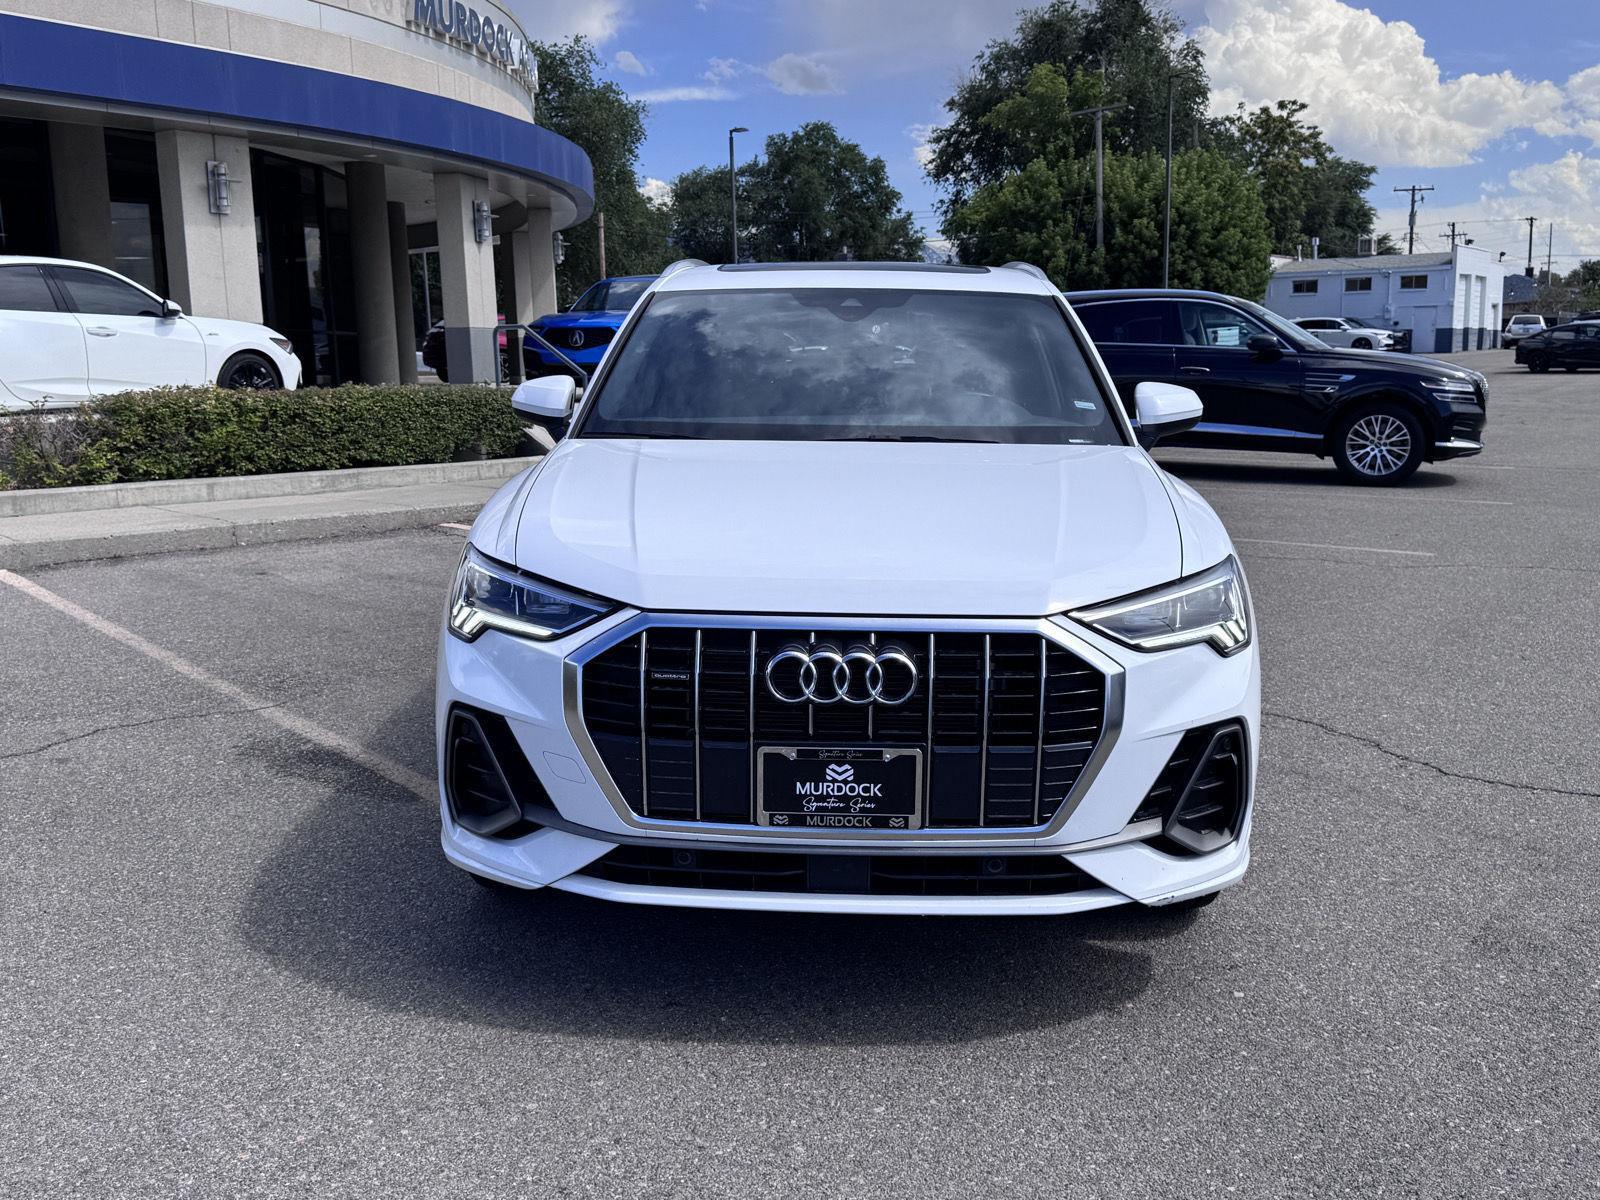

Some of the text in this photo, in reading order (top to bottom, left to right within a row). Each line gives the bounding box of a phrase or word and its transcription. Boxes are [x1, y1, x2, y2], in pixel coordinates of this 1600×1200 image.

[413, 0, 515, 66] MURDOCK
[818, 749, 863, 760] Signature Series
[796, 782, 882, 797] MURDOCK
[802, 796, 876, 813] Signature Series
[806, 815, 872, 827] MURDOCK
